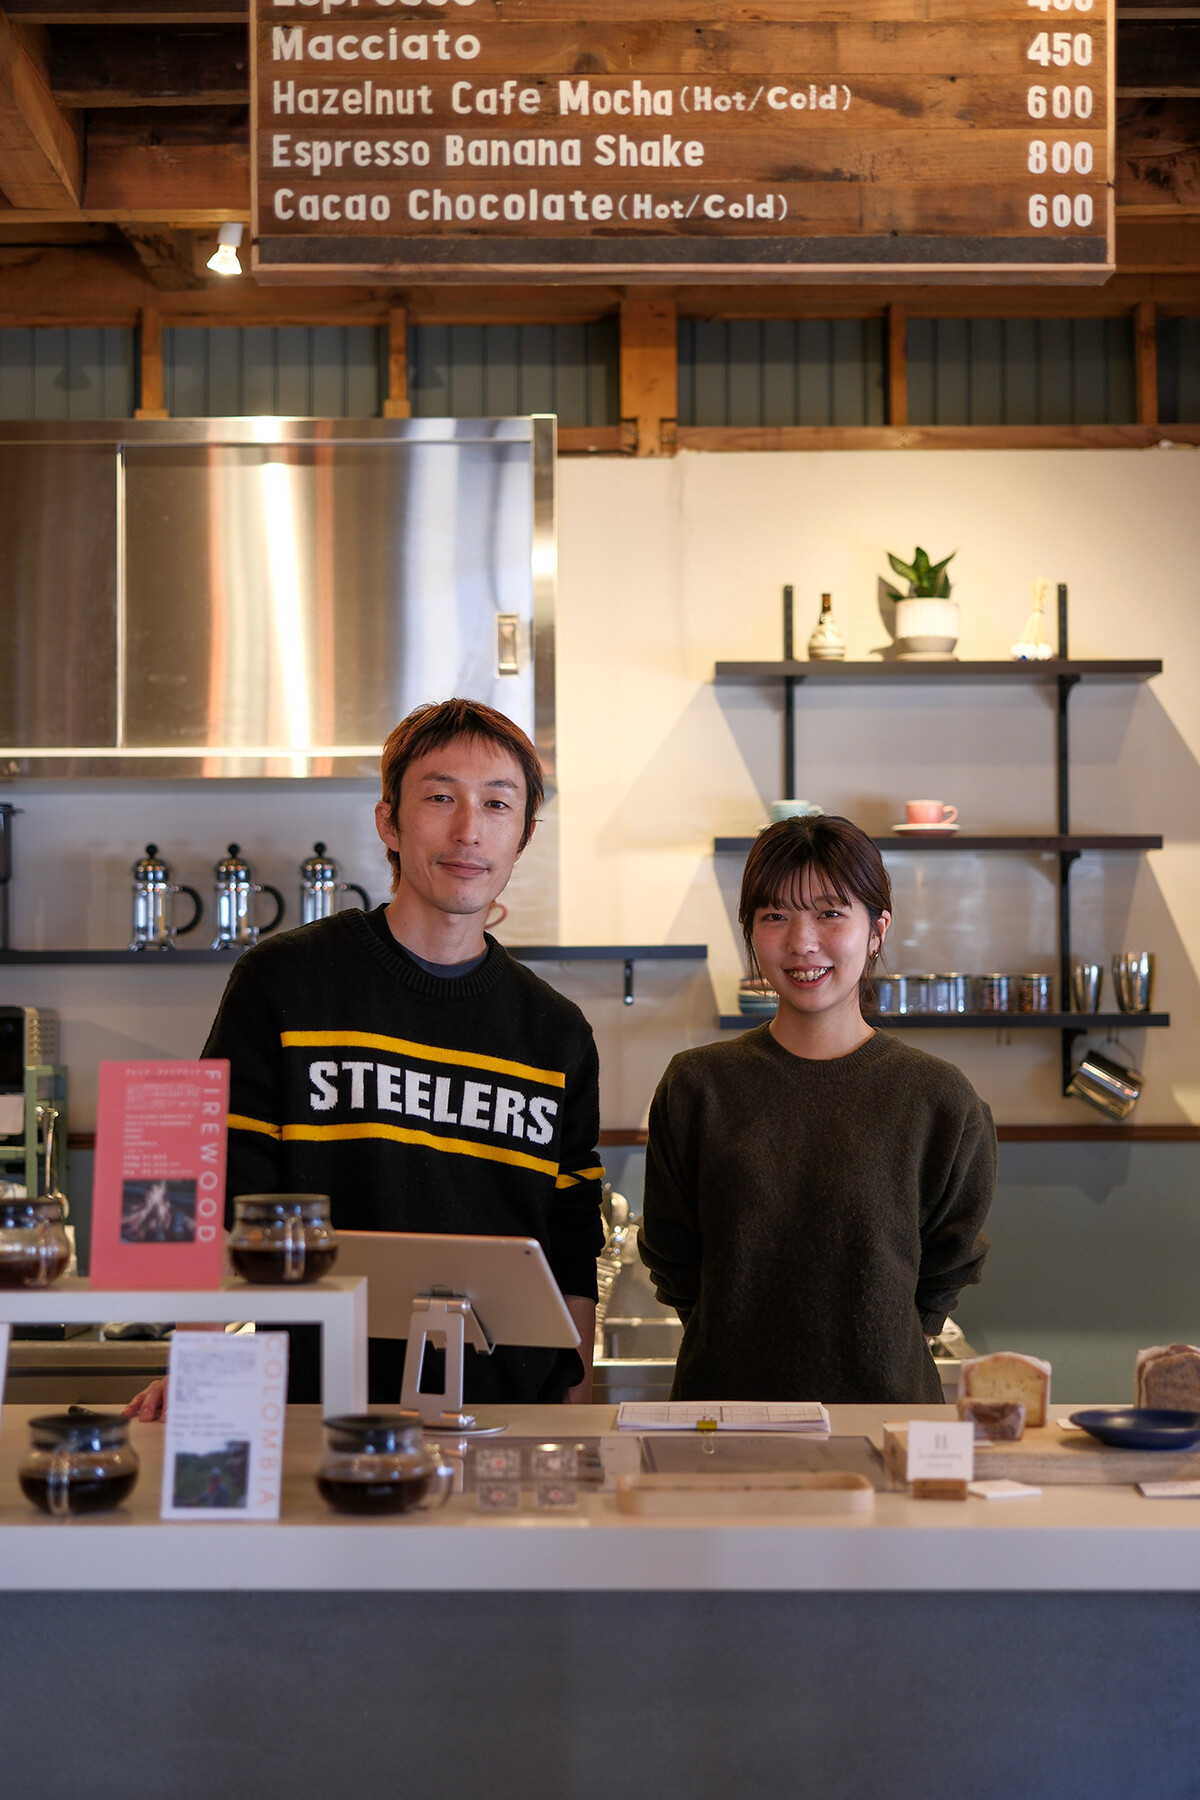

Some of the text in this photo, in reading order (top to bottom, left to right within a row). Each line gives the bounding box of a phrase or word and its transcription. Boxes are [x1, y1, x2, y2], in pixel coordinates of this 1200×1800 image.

[272, 27, 481, 61] Macciato
[1026, 32, 1093, 66] 450
[273, 80, 433, 115] Hazelnut
[451, 80, 541, 115] Cafe
[1027, 85, 1093, 119] 600
[272, 133, 705, 176] Espresso Banana Shake
[1027, 140, 1094, 175] 800
[274, 188, 391, 221] Cacao
[1028, 193, 1093, 228] 600
[309, 1061, 558, 1145] STEELERS
[196, 1069, 222, 1244] FIREWOOD
[258, 1334, 285, 1506] COLOMBIA
